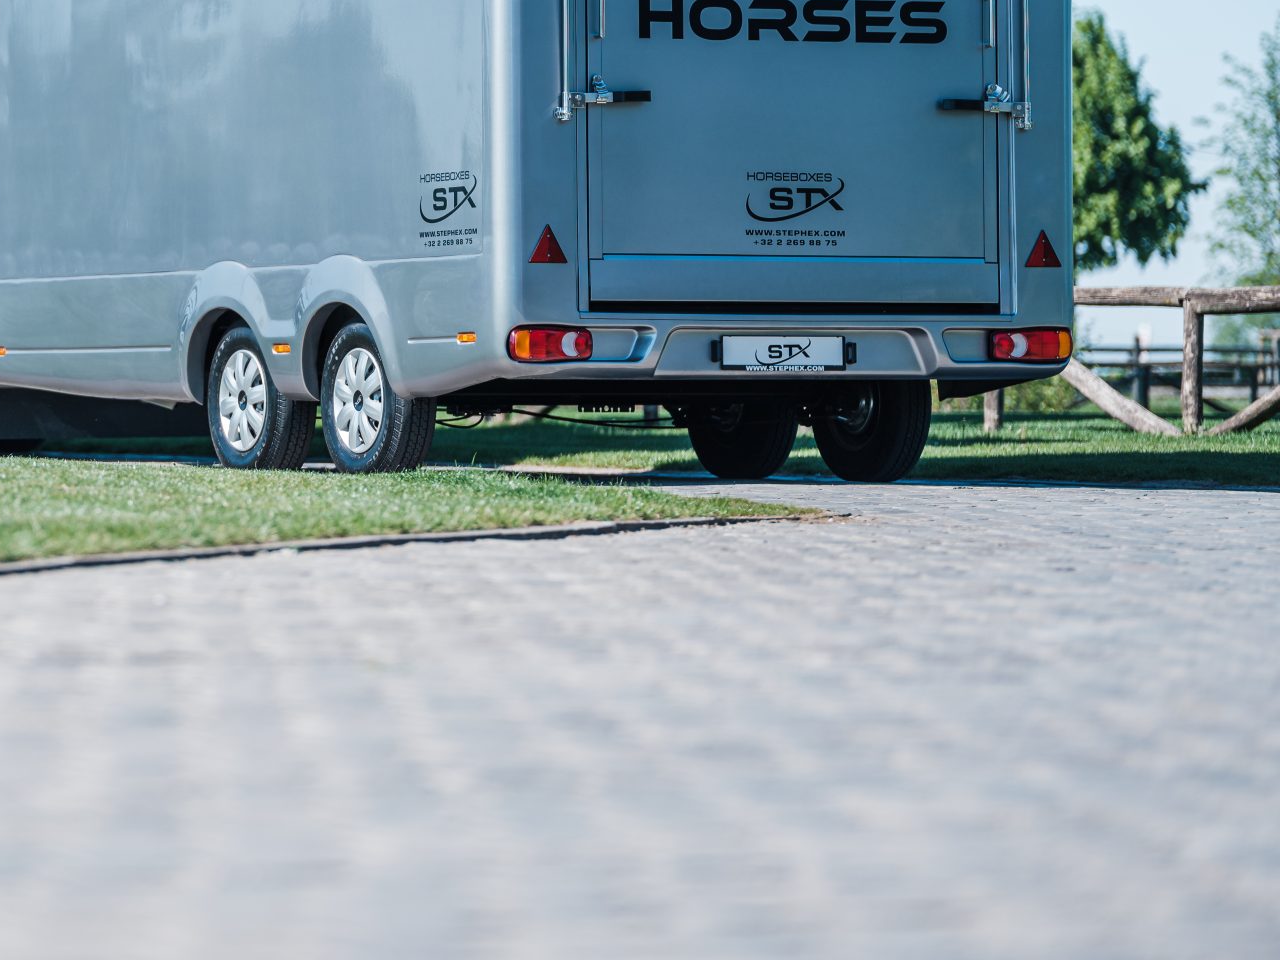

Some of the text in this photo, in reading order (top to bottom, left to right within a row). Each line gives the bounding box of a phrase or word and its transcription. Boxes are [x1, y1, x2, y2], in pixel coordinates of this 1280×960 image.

[419, 171, 470, 183] HORSEBOXES
[746, 171, 833, 182] HORSEBOXES
[432, 178, 477, 211] STX
[769, 178, 845, 212] STX
[419, 228, 478, 239] WWW.STEPHEX.COM
[745, 229, 846, 237] WWW.STEPHEX.COM
[768, 339, 811, 359] STX
